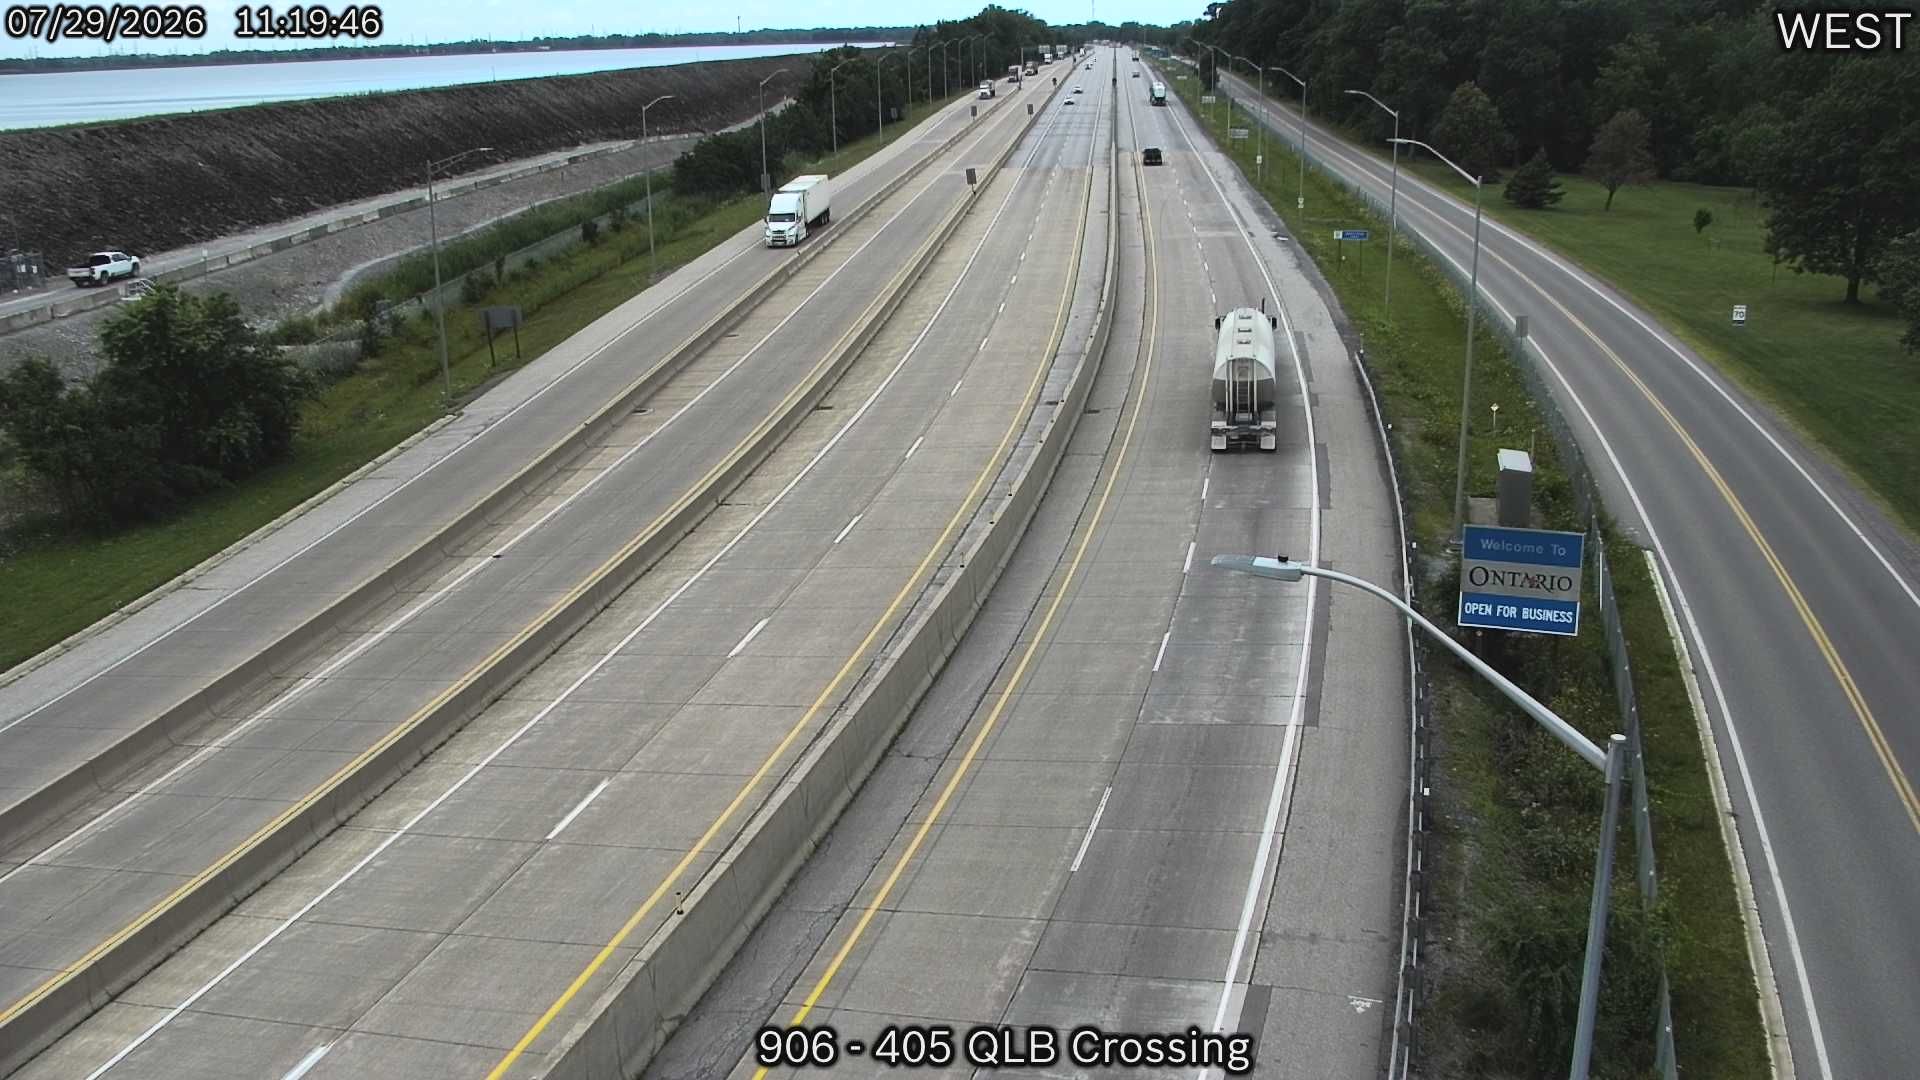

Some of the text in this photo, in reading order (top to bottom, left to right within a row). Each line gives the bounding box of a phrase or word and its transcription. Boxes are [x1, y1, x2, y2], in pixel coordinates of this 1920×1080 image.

[1480, 538, 1567, 556] Welcome To
[1469, 566, 1573, 593] ONTARIO
[1464, 602, 1573, 624] OPEN FOR BUSINESS
